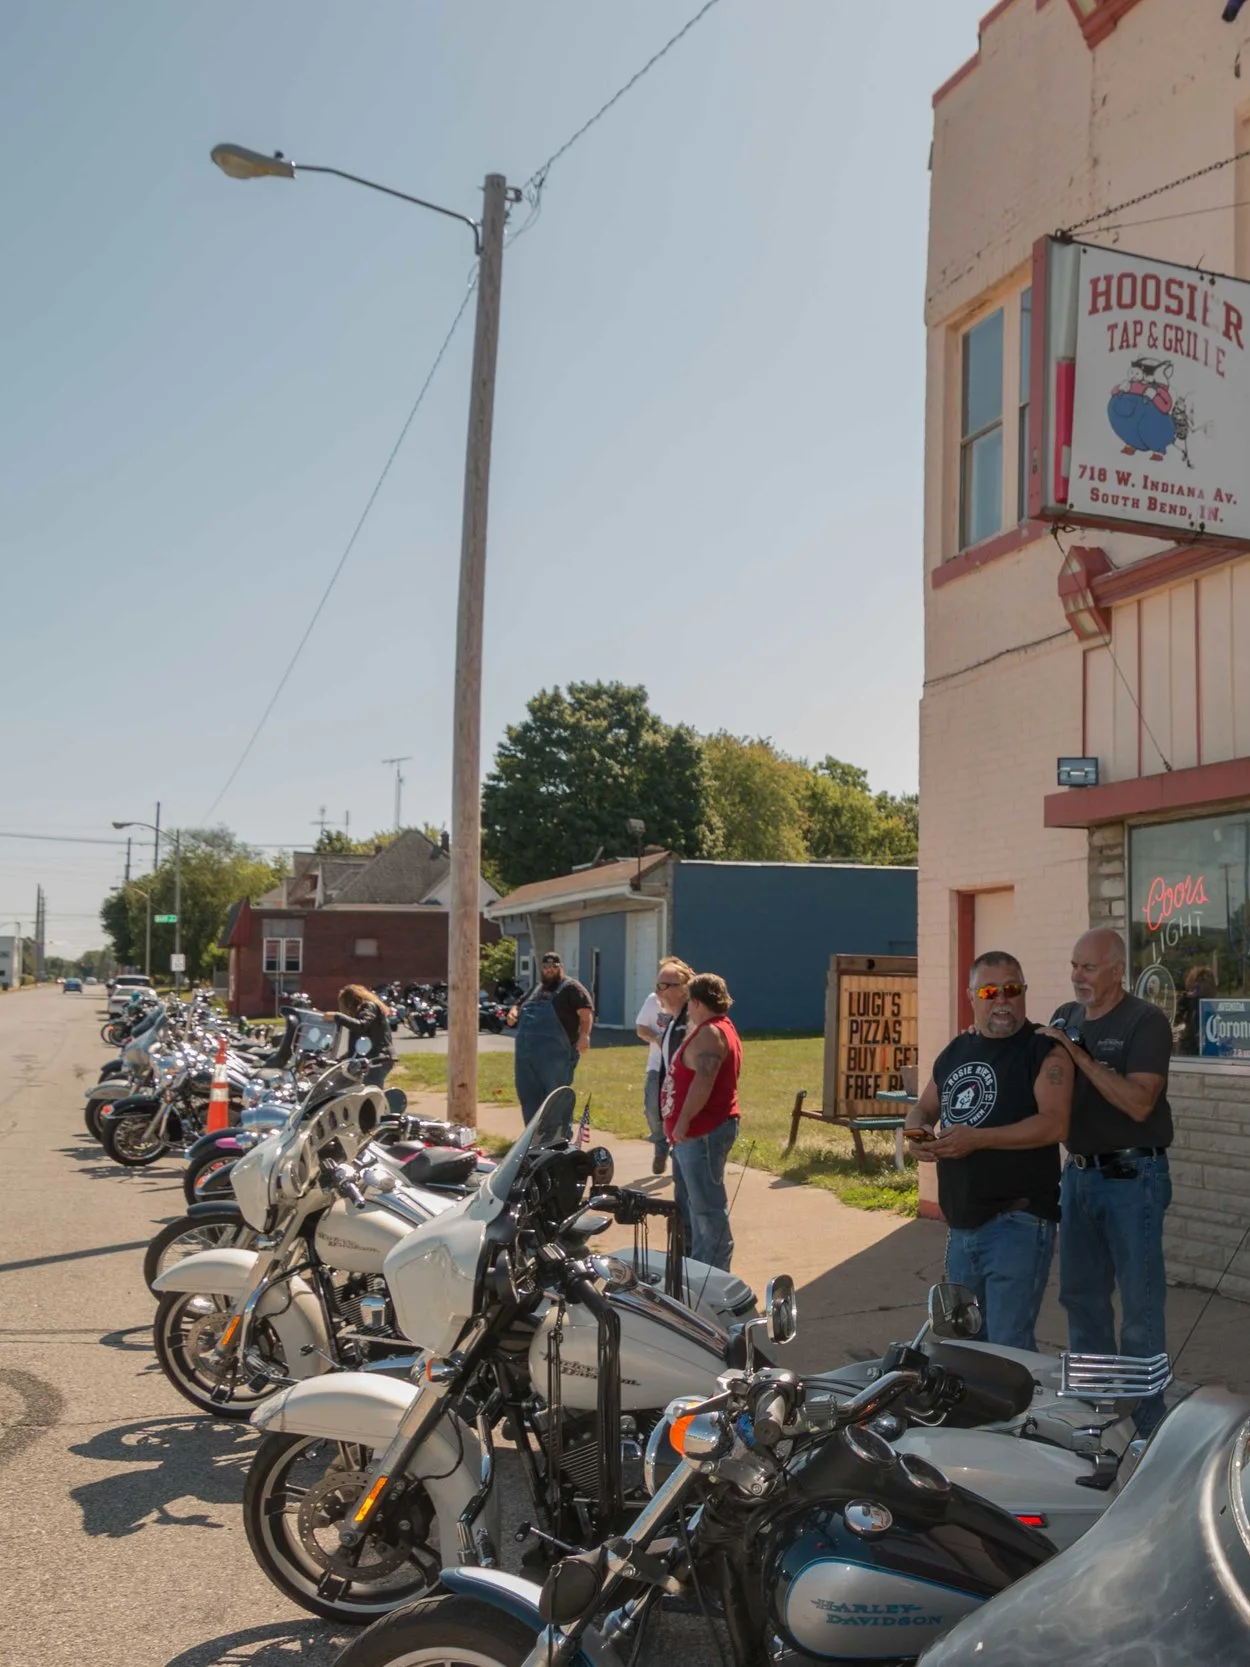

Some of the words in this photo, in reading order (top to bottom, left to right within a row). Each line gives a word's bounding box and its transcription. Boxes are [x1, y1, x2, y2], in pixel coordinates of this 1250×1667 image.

[1088, 272, 1243, 350] HOOSIER
[1107, 320, 1143, 352] TAP
[1079, 465, 1106, 482] 718
[1116, 470, 1135, 488] W.
[1142, 875, 1208, 931] Coors
[849, 1019, 902, 1045] PIZZAS
[847, 1046, 877, 1072] BUY
[845, 1074, 882, 1100] FREE
[948, 1066, 973, 1086] ROSIE
[826, 1614, 943, 1627] DAVIDSON
